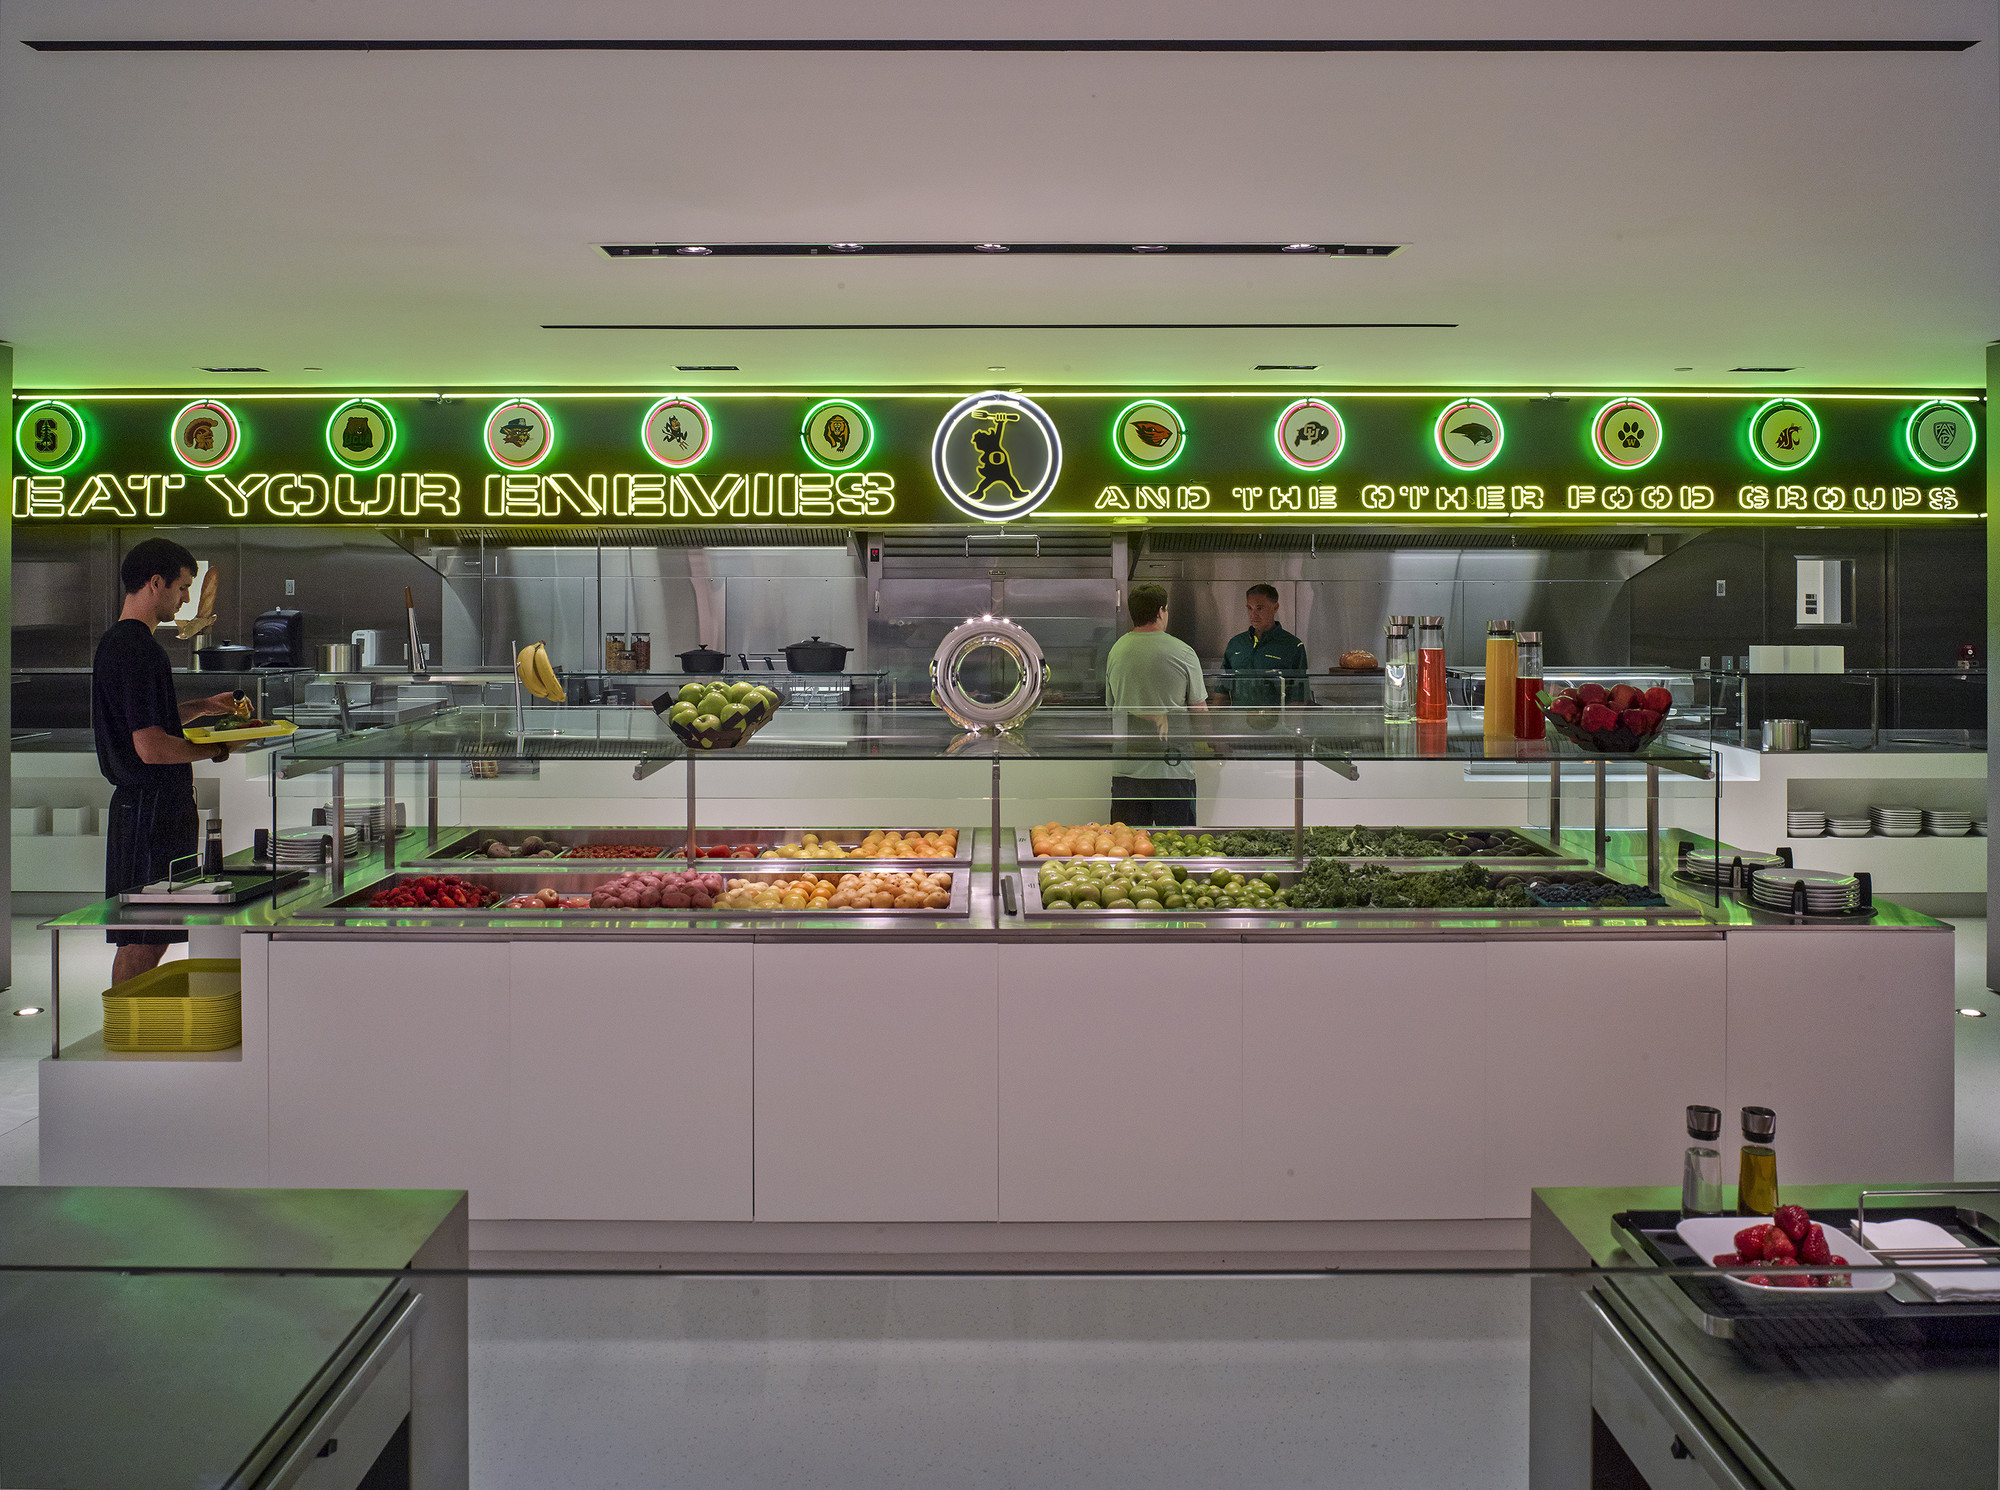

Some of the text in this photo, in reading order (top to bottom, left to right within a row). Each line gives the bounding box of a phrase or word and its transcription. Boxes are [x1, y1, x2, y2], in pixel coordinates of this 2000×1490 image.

[1304, 423, 1320, 440] CU
[1940, 436, 1950, 444] 12
[1626, 438, 1636, 446] W
[12, 472, 896, 518] EAT YOUR ENEMIES
[1094, 485, 1959, 511] AND THE OTHER FOOD GROUPS
